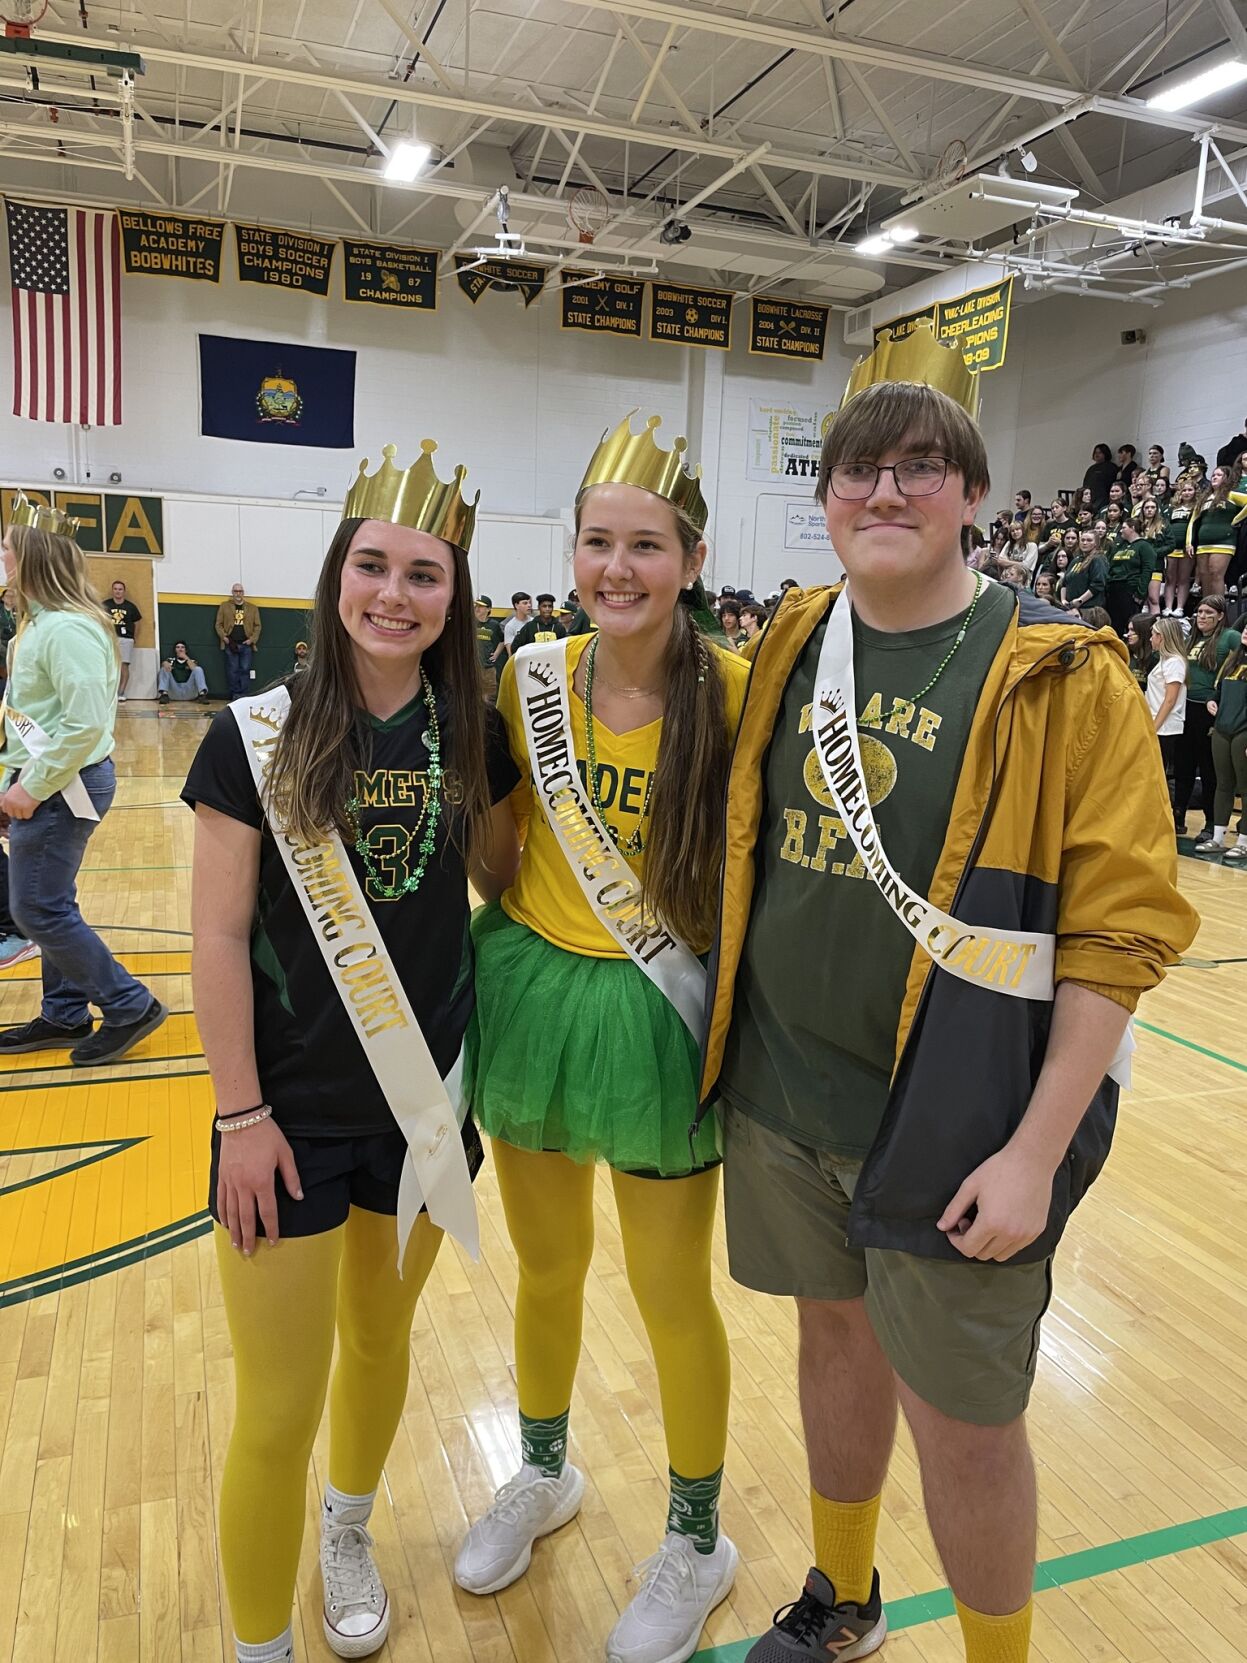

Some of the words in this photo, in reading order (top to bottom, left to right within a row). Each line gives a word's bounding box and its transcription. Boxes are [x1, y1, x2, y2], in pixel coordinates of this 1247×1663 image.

[122, 216, 183, 235] BELLOWS
[188, 224, 222, 240] FREE
[140, 234, 206, 252] ACADEMY
[241, 229, 272, 243] STATE
[278, 235, 320, 253] DIVISION
[130, 251, 215, 275] BOBWHITES
[241, 242, 273, 256] BOYS
[278, 248, 328, 268] SOCCER
[349, 256, 372, 265] BOYS
[376, 260, 432, 273] BASKETBALL
[352, 247, 381, 257] STATE
[385, 251, 420, 262] DIVISION
[244, 255, 325, 280] CHAMPIONS
[506, 267, 538, 280] SOCCER
[359, 288, 423, 303] CHAMPIONS
[614, 283, 641, 294] GOLF
[657, 290, 694, 305] BOBWHITE
[697, 296, 727, 309] SOCCER
[567, 311, 592, 325] STATE
[594, 314, 637, 330] CHAMPIONS
[757, 303, 788, 316] BOBWHITE
[791, 307, 824, 321] LACROSSE
[940, 306, 1004, 338] CHEERLEADING
[656, 322, 681, 336] STATE
[684, 325, 725, 341] CHAMPIONS
[965, 326, 998, 349] PIONS
[756, 335, 779, 349] STATE
[781, 338, 820, 354] CHAMPIONS
[527, 686, 620, 882] HOMECOMING
[818, 709, 929, 929] HOMECOMING
[365, 824, 411, 902] 3
[333, 943, 409, 1039] COURT
